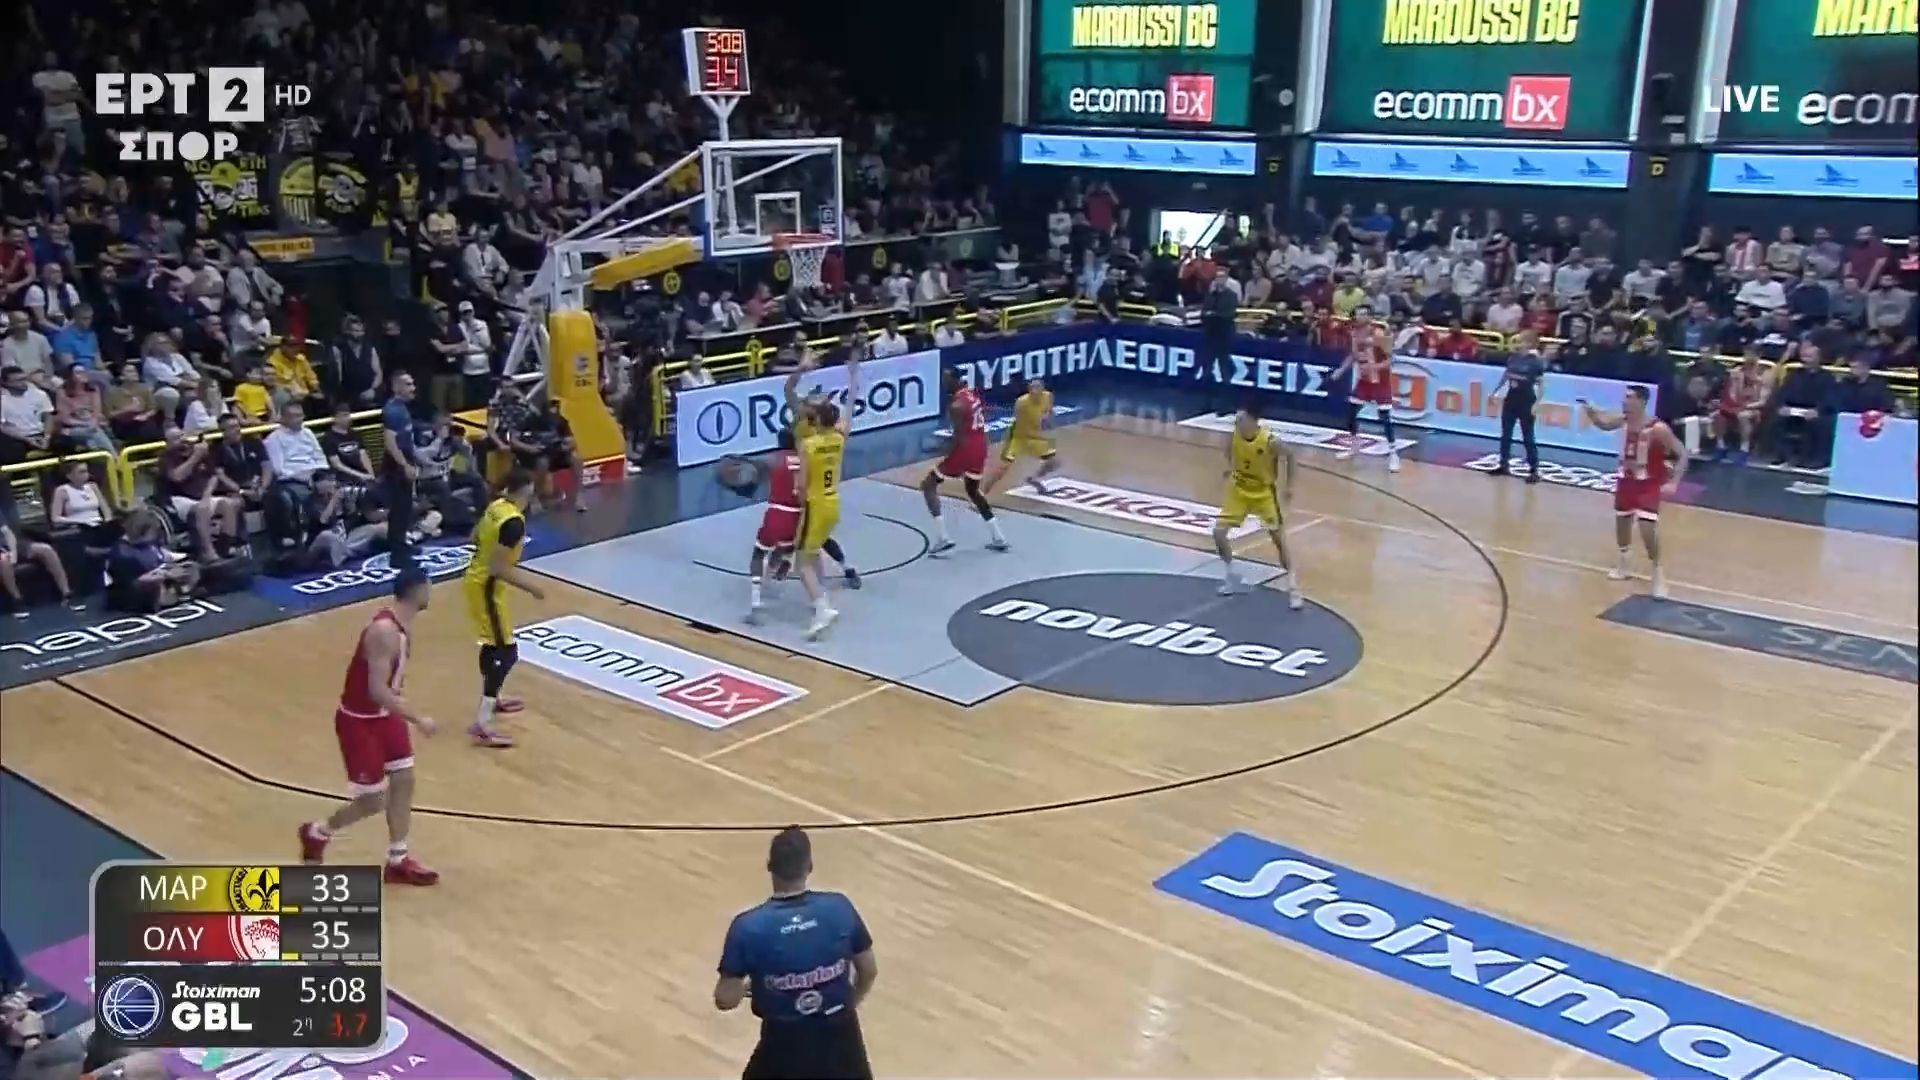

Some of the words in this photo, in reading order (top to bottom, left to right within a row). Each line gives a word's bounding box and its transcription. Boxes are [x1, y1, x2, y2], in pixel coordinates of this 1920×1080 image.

[707, 33, 741, 53] 5:08
[1073, 6, 1182, 47] MAROUSSI
[1186, 4, 1218, 47] BC
[1383, 0, 1529, 44] MAROUSSI
[1535, 0, 1579, 43] BC
[979, 599, 1328, 677] novibet
